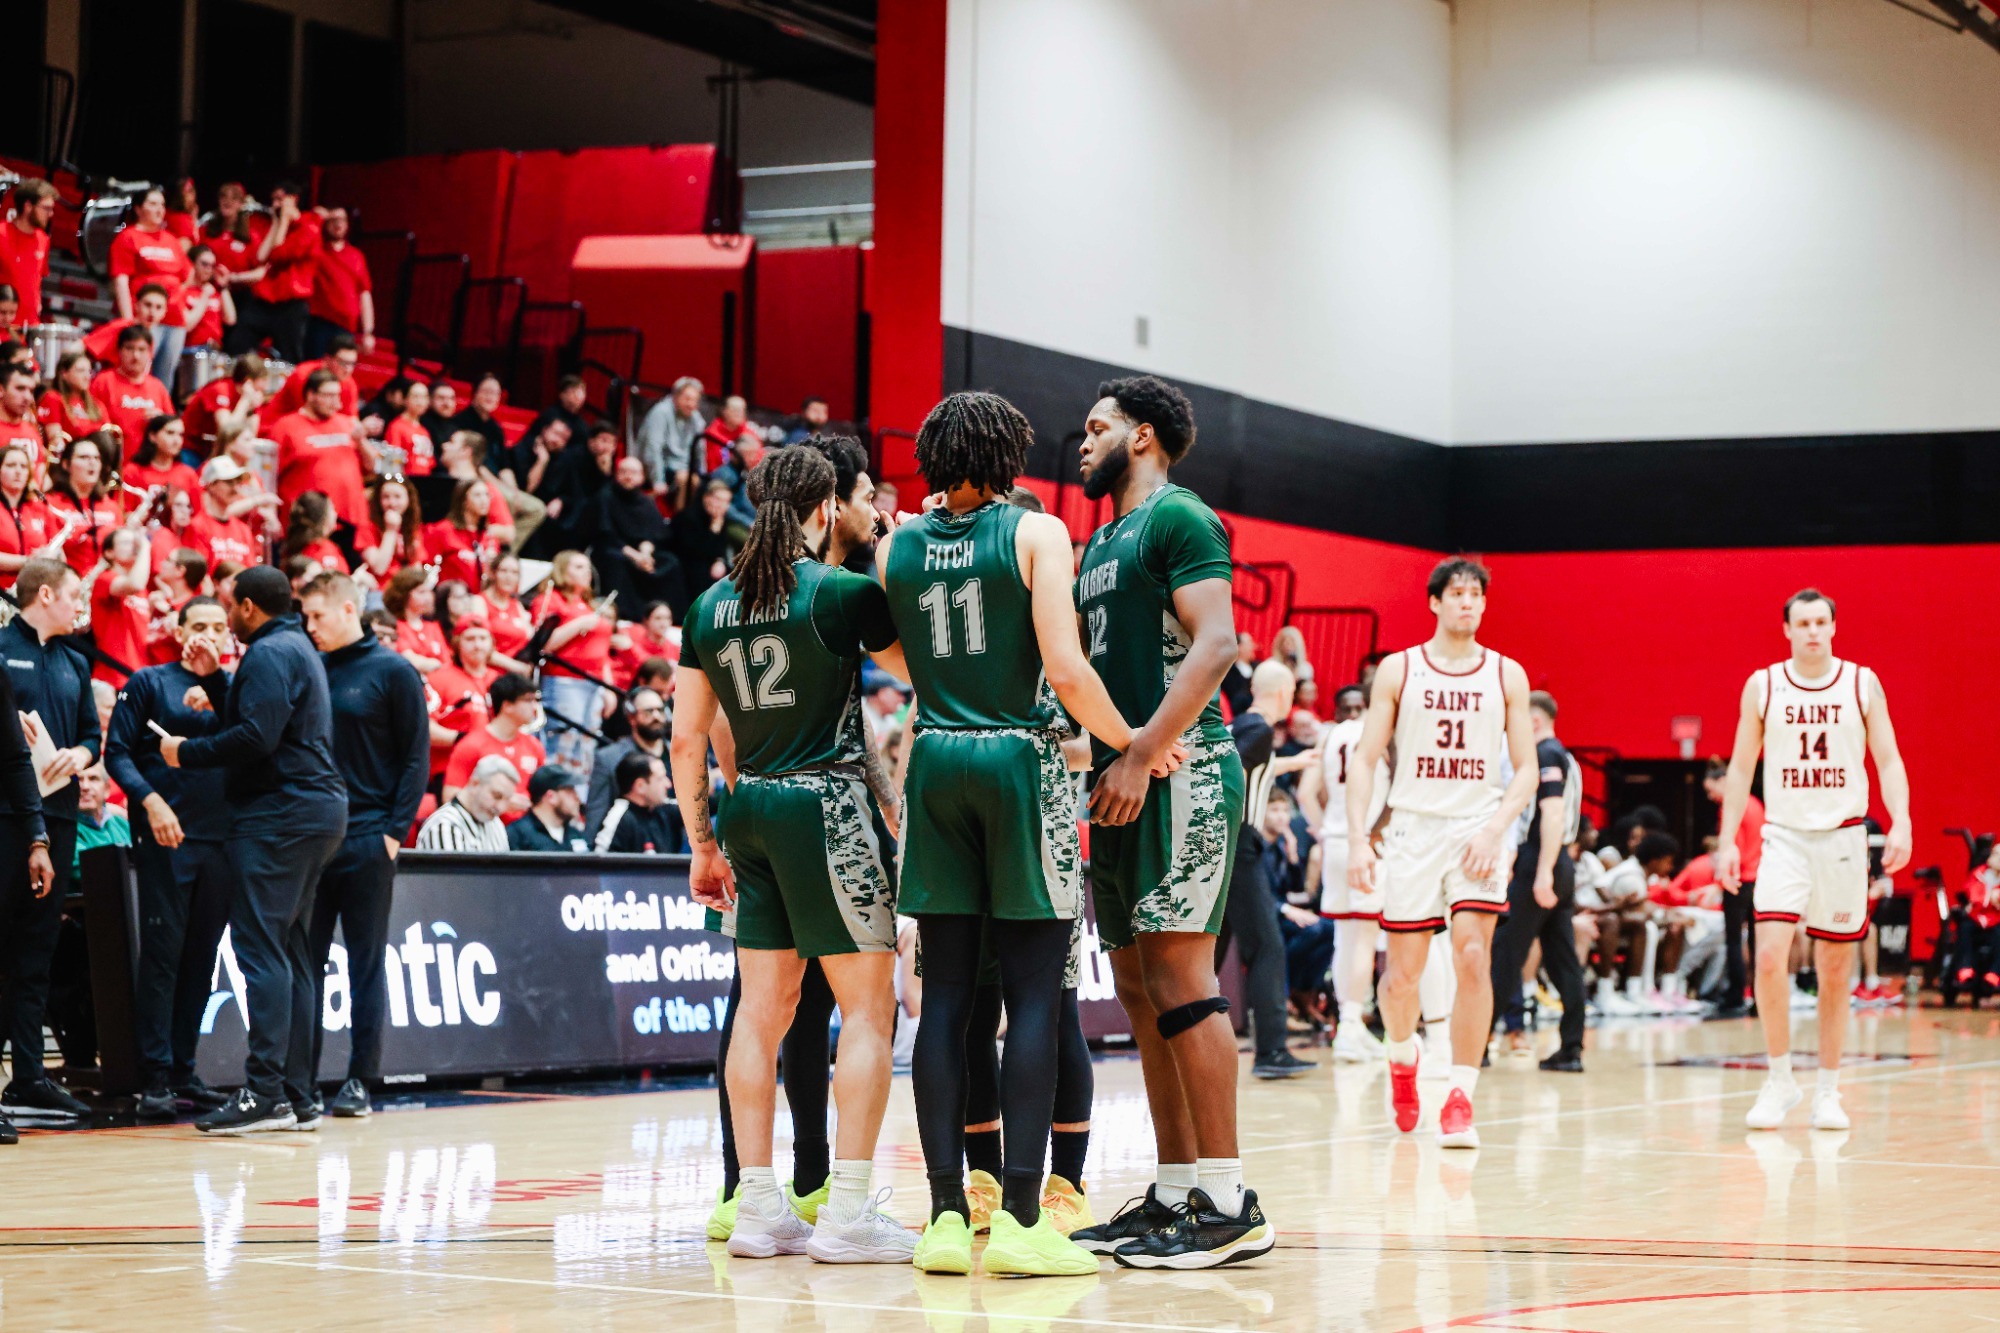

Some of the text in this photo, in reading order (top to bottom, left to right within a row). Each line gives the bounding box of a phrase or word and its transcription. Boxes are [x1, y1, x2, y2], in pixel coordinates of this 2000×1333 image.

[924, 540, 974, 571] FITCH
[713, 593, 790, 629] WILIAMS
[918, 577, 986, 658] 11
[717, 633, 795, 711] 12
[1424, 689, 1483, 712] SAINT
[1785, 704, 1842, 724] SAINT
[1436, 718, 1466, 750] 31
[1799, 731, 1828, 760] 14
[1416, 756, 1485, 780] FRANCIS
[1782, 768, 1846, 788] FRANCIS
[561, 890, 661, 931] Official
[199, 921, 501, 1034] Aatic
[605, 945, 659, 983] and
[633, 997, 662, 1034] of
[665, 996, 711, 1033] the
